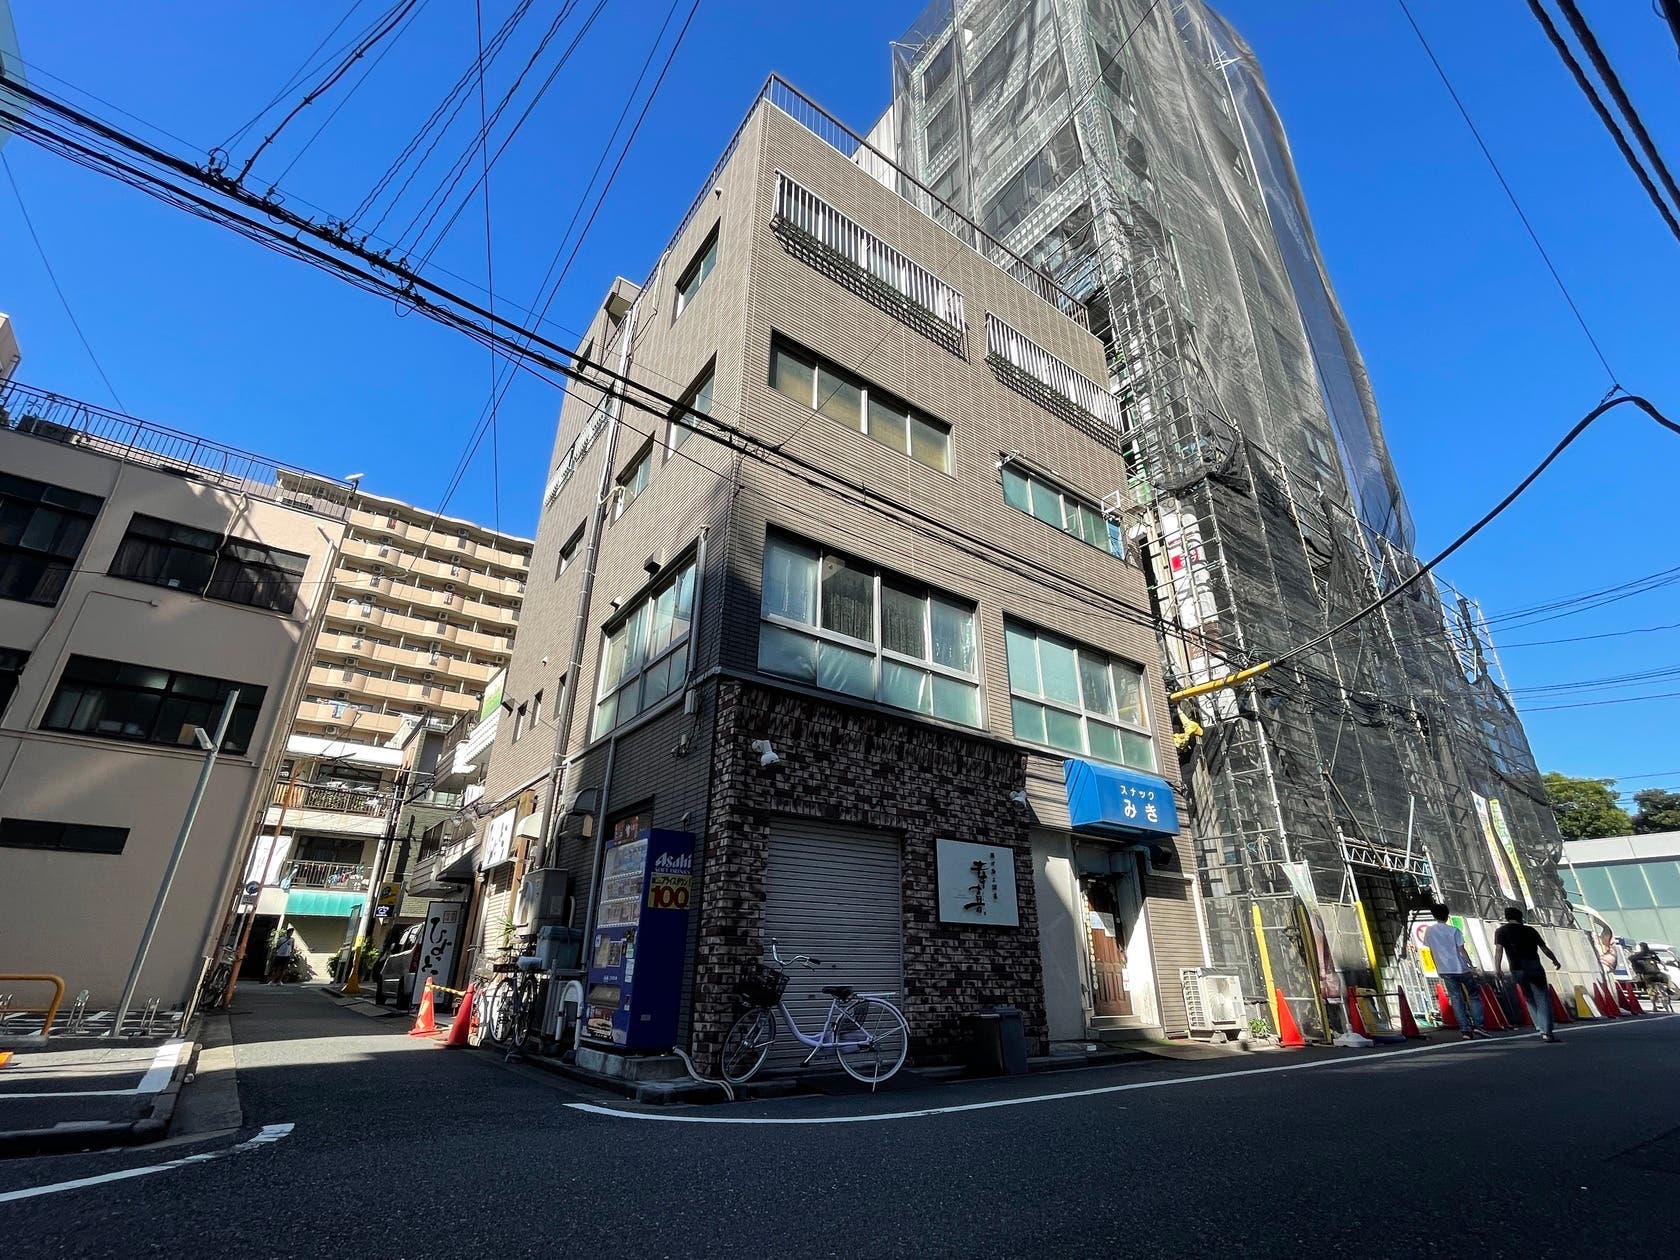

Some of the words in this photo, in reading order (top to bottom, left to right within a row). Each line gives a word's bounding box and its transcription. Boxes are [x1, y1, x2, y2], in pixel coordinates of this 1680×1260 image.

[1119, 784, 1155, 801] スナック
[1123, 798, 1158, 823] みき
[655, 852, 692, 868] Asahi
[651, 885, 690, 908] 100
